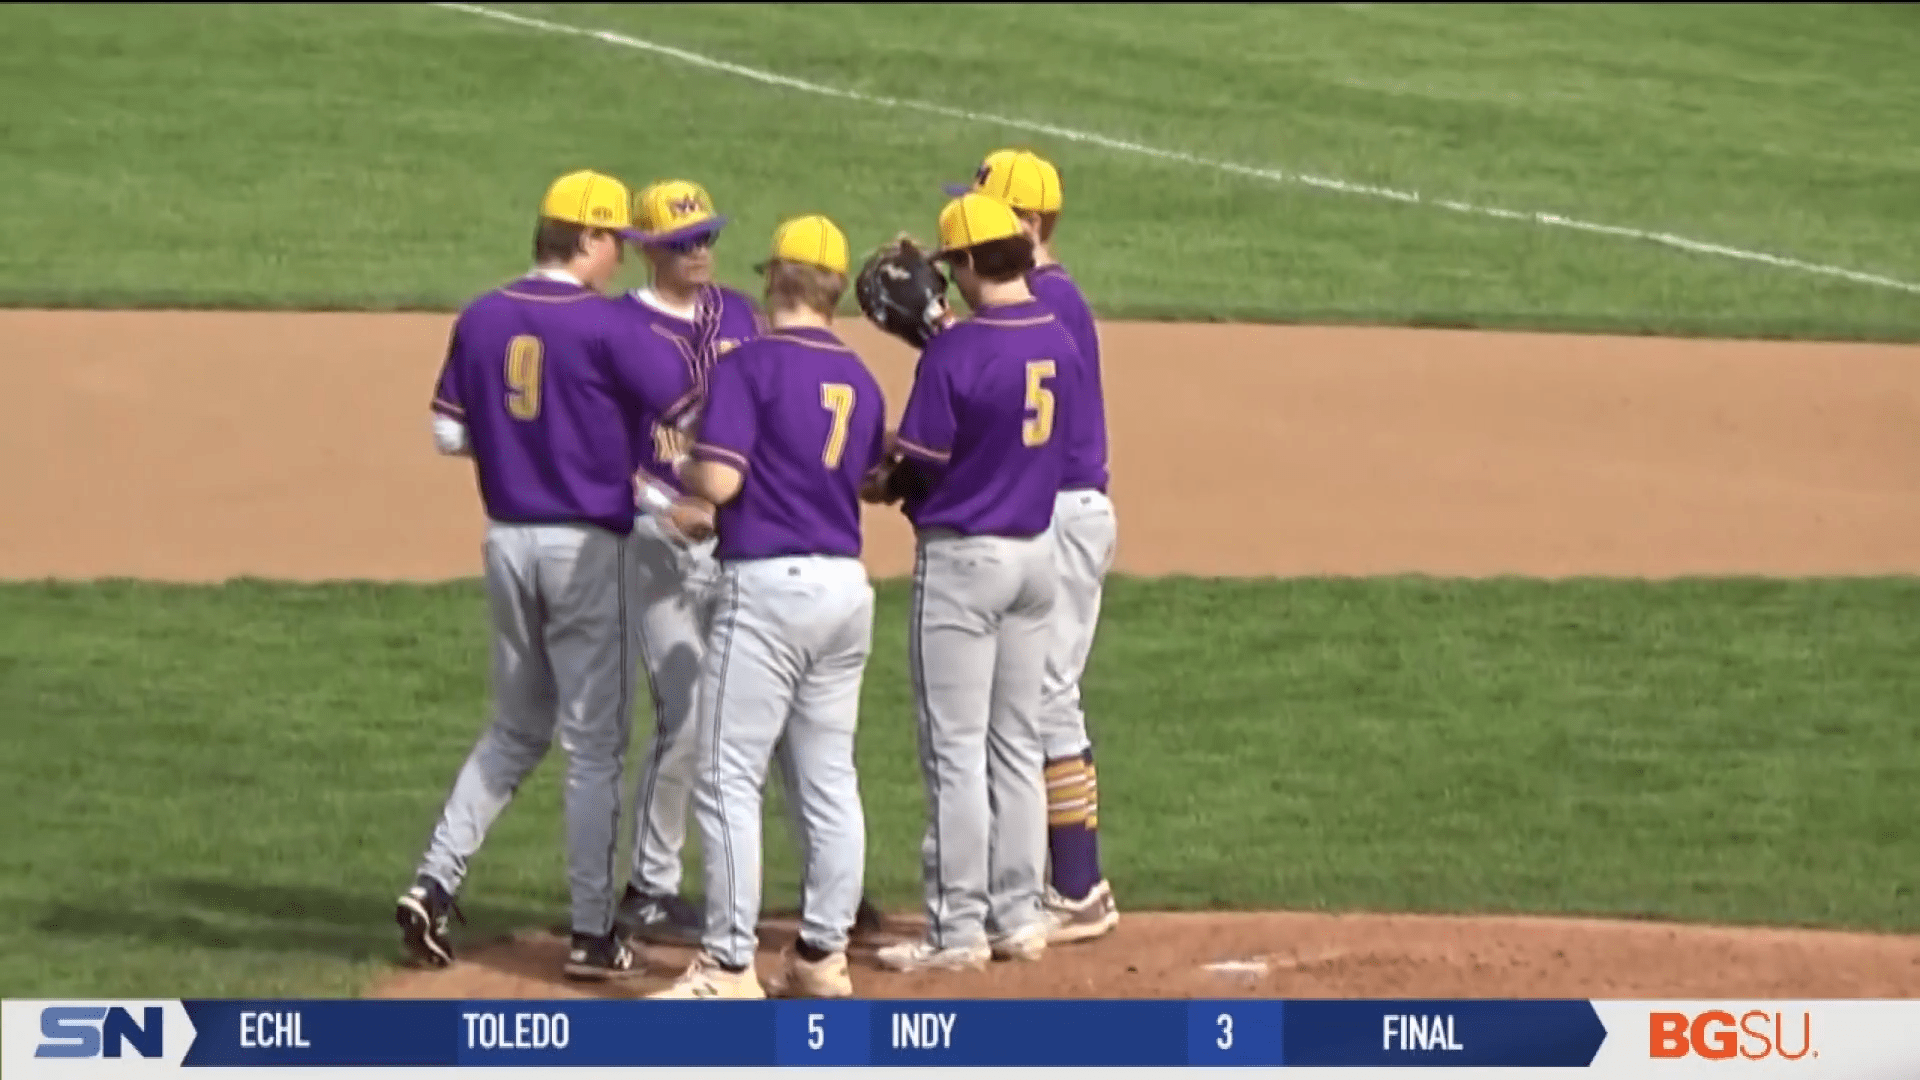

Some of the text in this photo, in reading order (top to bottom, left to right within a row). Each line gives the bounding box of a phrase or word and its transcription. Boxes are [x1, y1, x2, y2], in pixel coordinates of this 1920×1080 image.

[505, 333, 544, 420] 9
[1022, 360, 1056, 447] 5
[821, 382, 855, 469] 7
